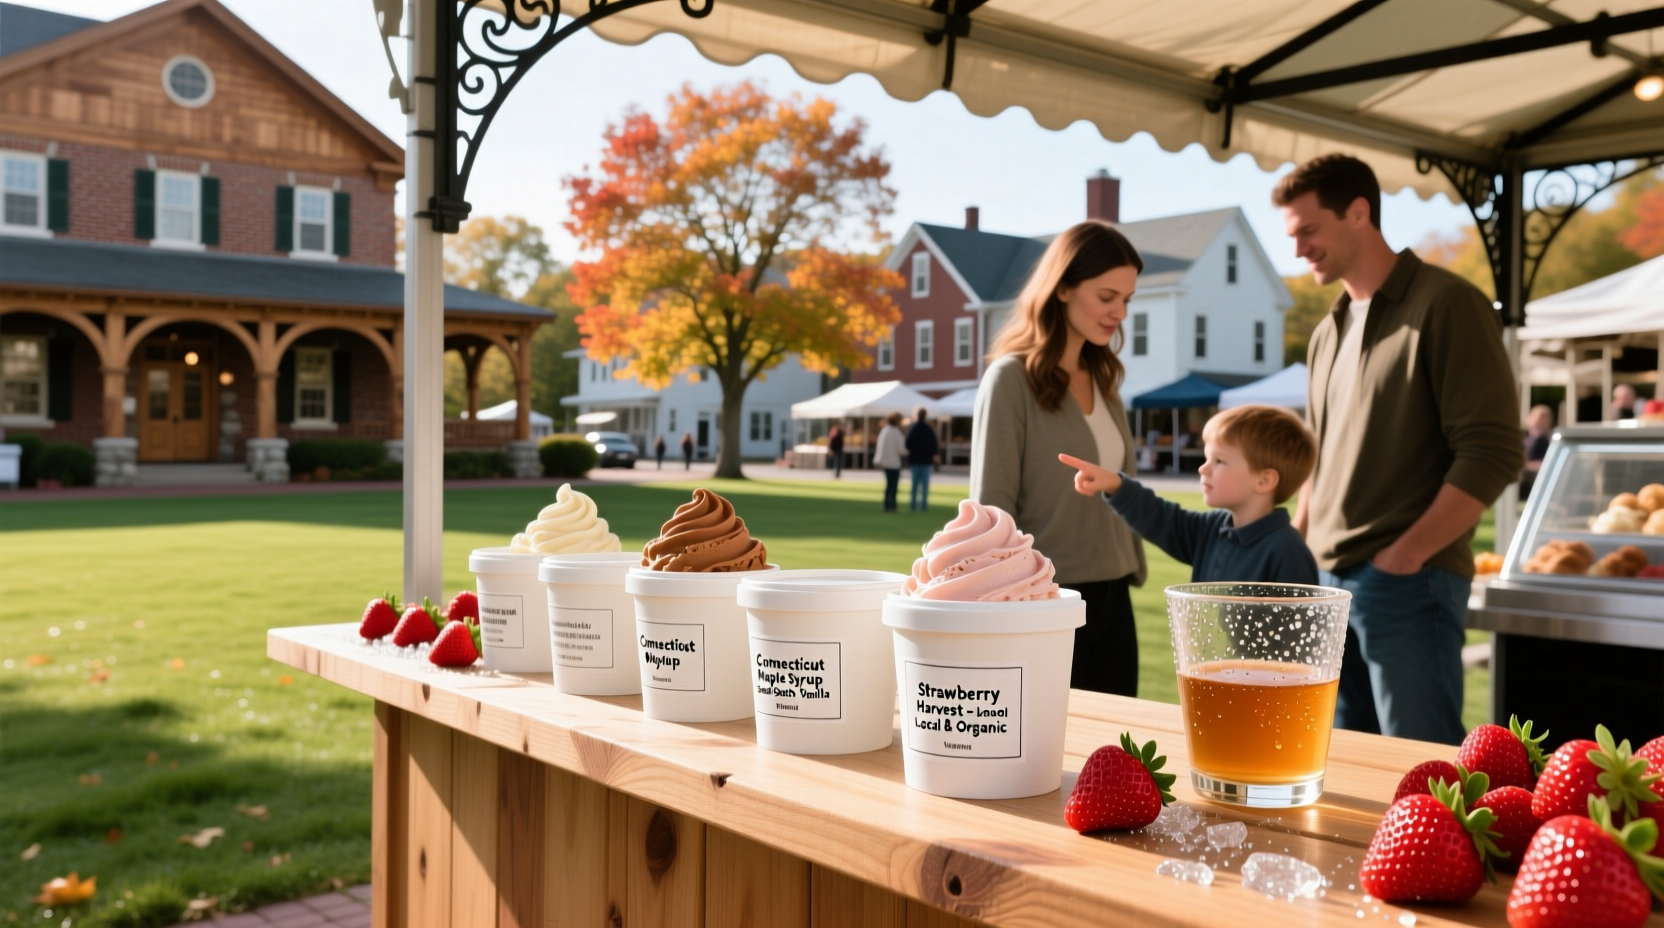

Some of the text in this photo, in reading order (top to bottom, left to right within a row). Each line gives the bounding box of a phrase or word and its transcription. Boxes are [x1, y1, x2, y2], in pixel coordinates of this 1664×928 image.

[788, 673, 823, 690] Syrup
[918, 682, 1000, 705] Strawberry
[917, 700, 964, 717] Harvest
[914, 716, 1008, 738] Local & Organic
